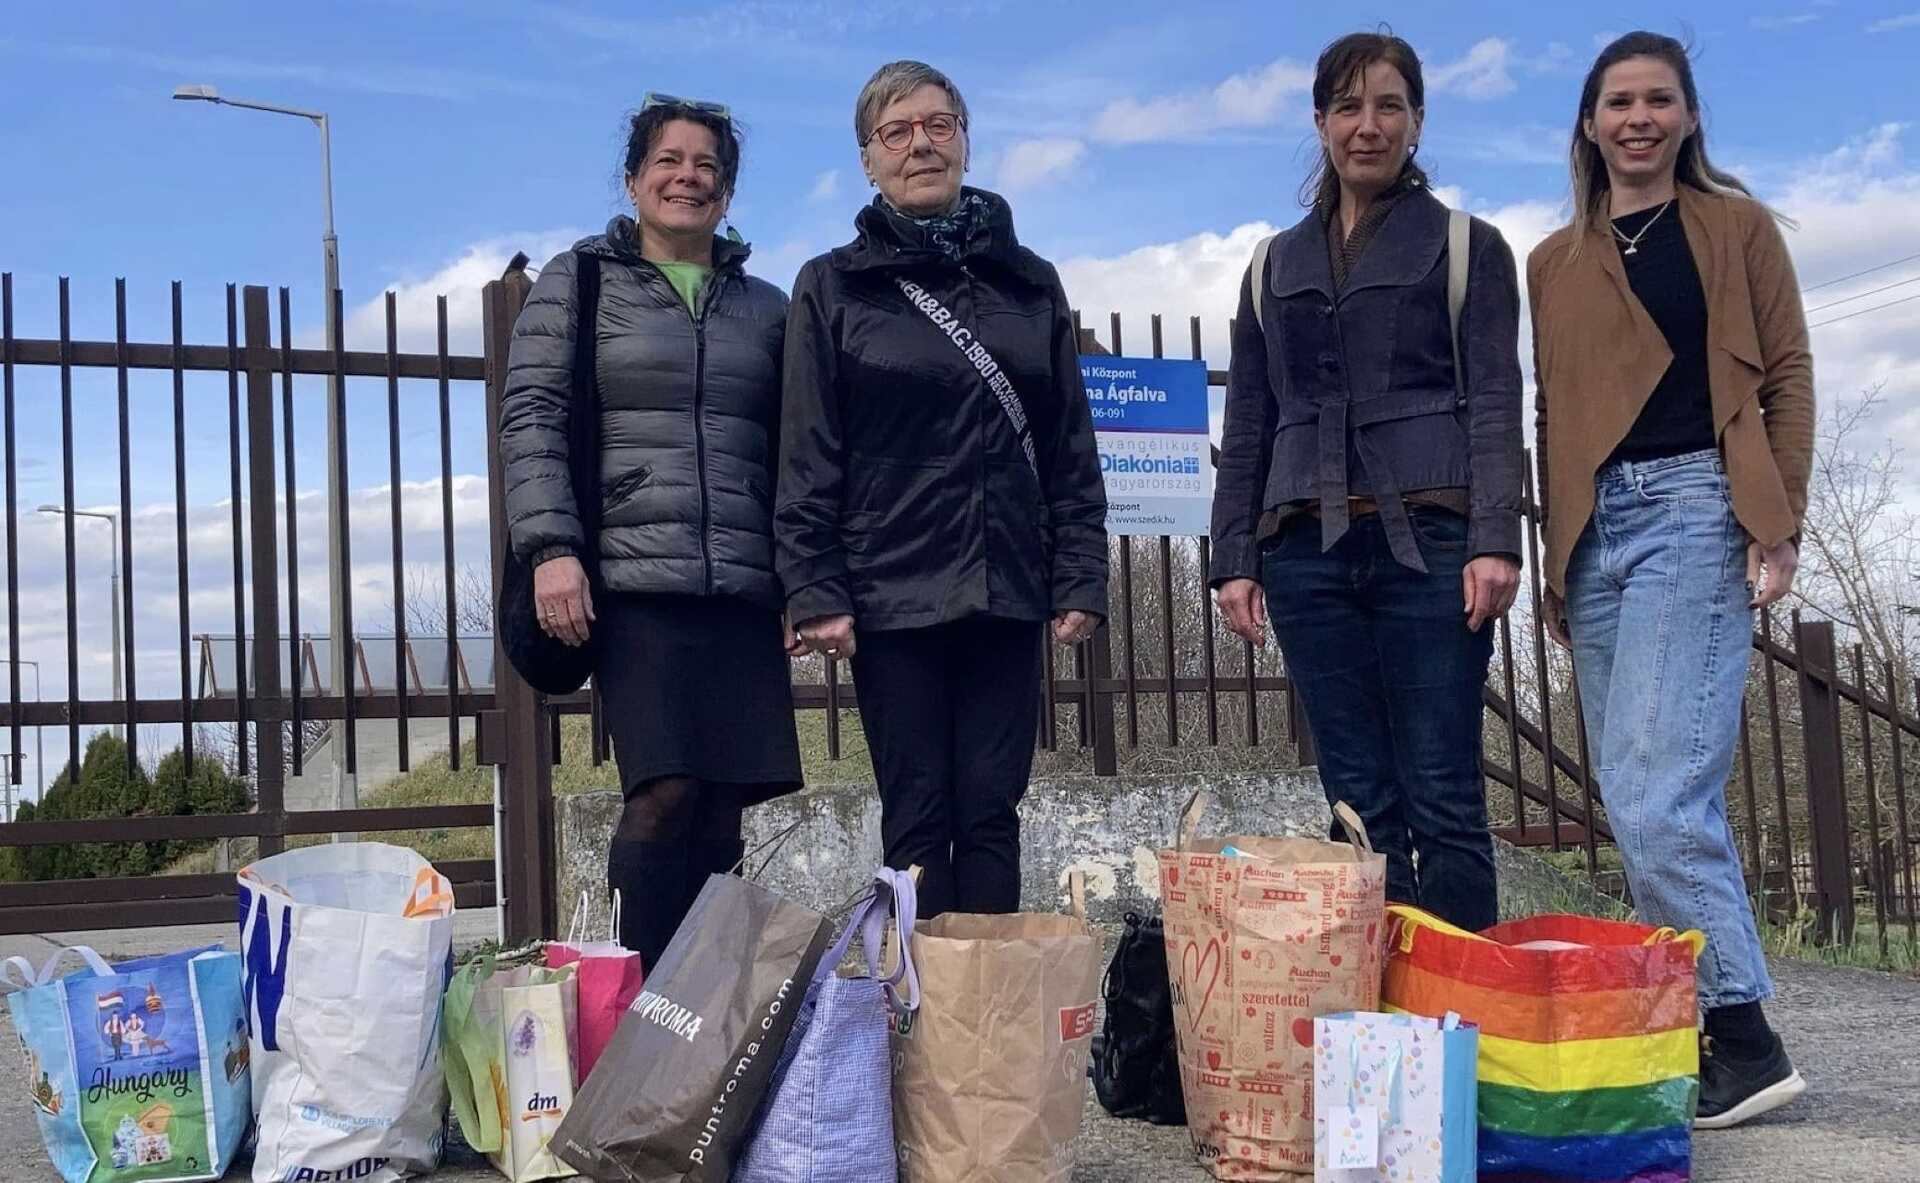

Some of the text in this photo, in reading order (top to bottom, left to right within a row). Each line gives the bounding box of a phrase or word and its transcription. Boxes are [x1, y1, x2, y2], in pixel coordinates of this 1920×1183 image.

[1092, 367, 1137, 380] Központ
[1107, 382, 1167, 404] Ágfalva
[1100, 453, 1184, 473] Diakónia
[1322, 883, 1336, 908] meg
[1289, 966, 1331, 978] Auchan
[1242, 993, 1310, 1008] szeretettel
[689, 978, 794, 1165] puntroma.com
[88, 1066, 193, 1104] Hungary
[528, 1092, 558, 1111] dm
